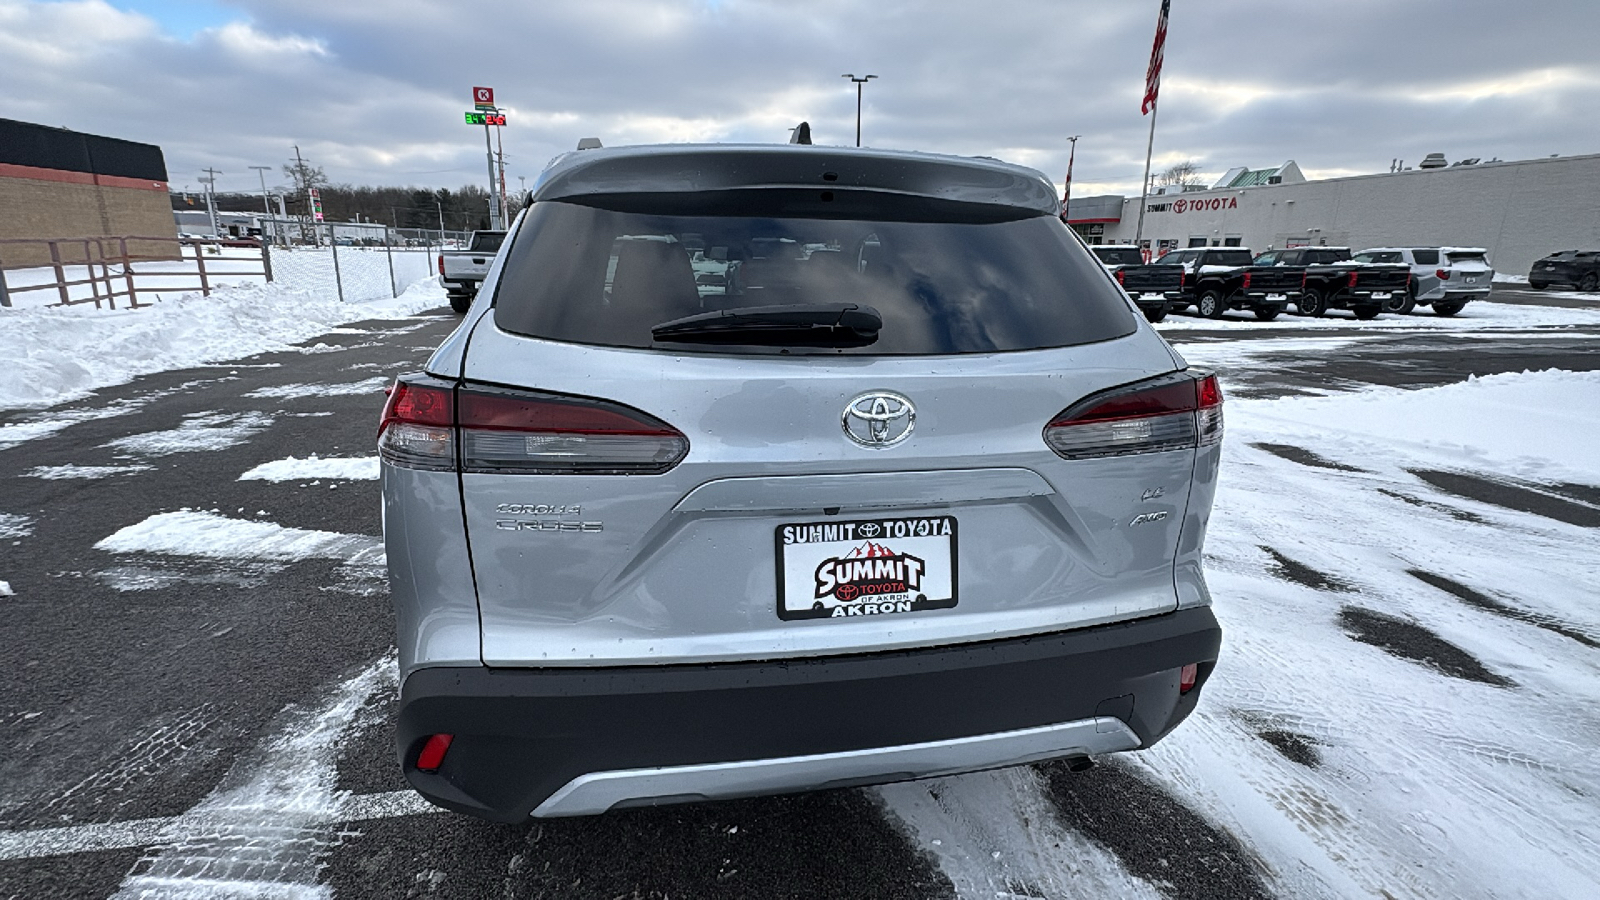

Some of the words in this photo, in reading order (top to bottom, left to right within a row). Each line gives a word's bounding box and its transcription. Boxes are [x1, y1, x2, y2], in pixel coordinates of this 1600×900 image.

[1147, 203, 1172, 212] SUMMIT
[1189, 197, 1237, 211] TOYOTA
[496, 503, 581, 515] COROLLA
[496, 519, 604, 533] CROSS
[1129, 510, 1167, 527] AWD
[783, 524, 856, 544] SUMMIT
[883, 518, 952, 539] TOYOTA
[818, 556, 921, 594] SUMMIT
[860, 582, 906, 594] TOYOTA
[876, 593, 909, 602] AKRON
[832, 601, 911, 617] AKRON
